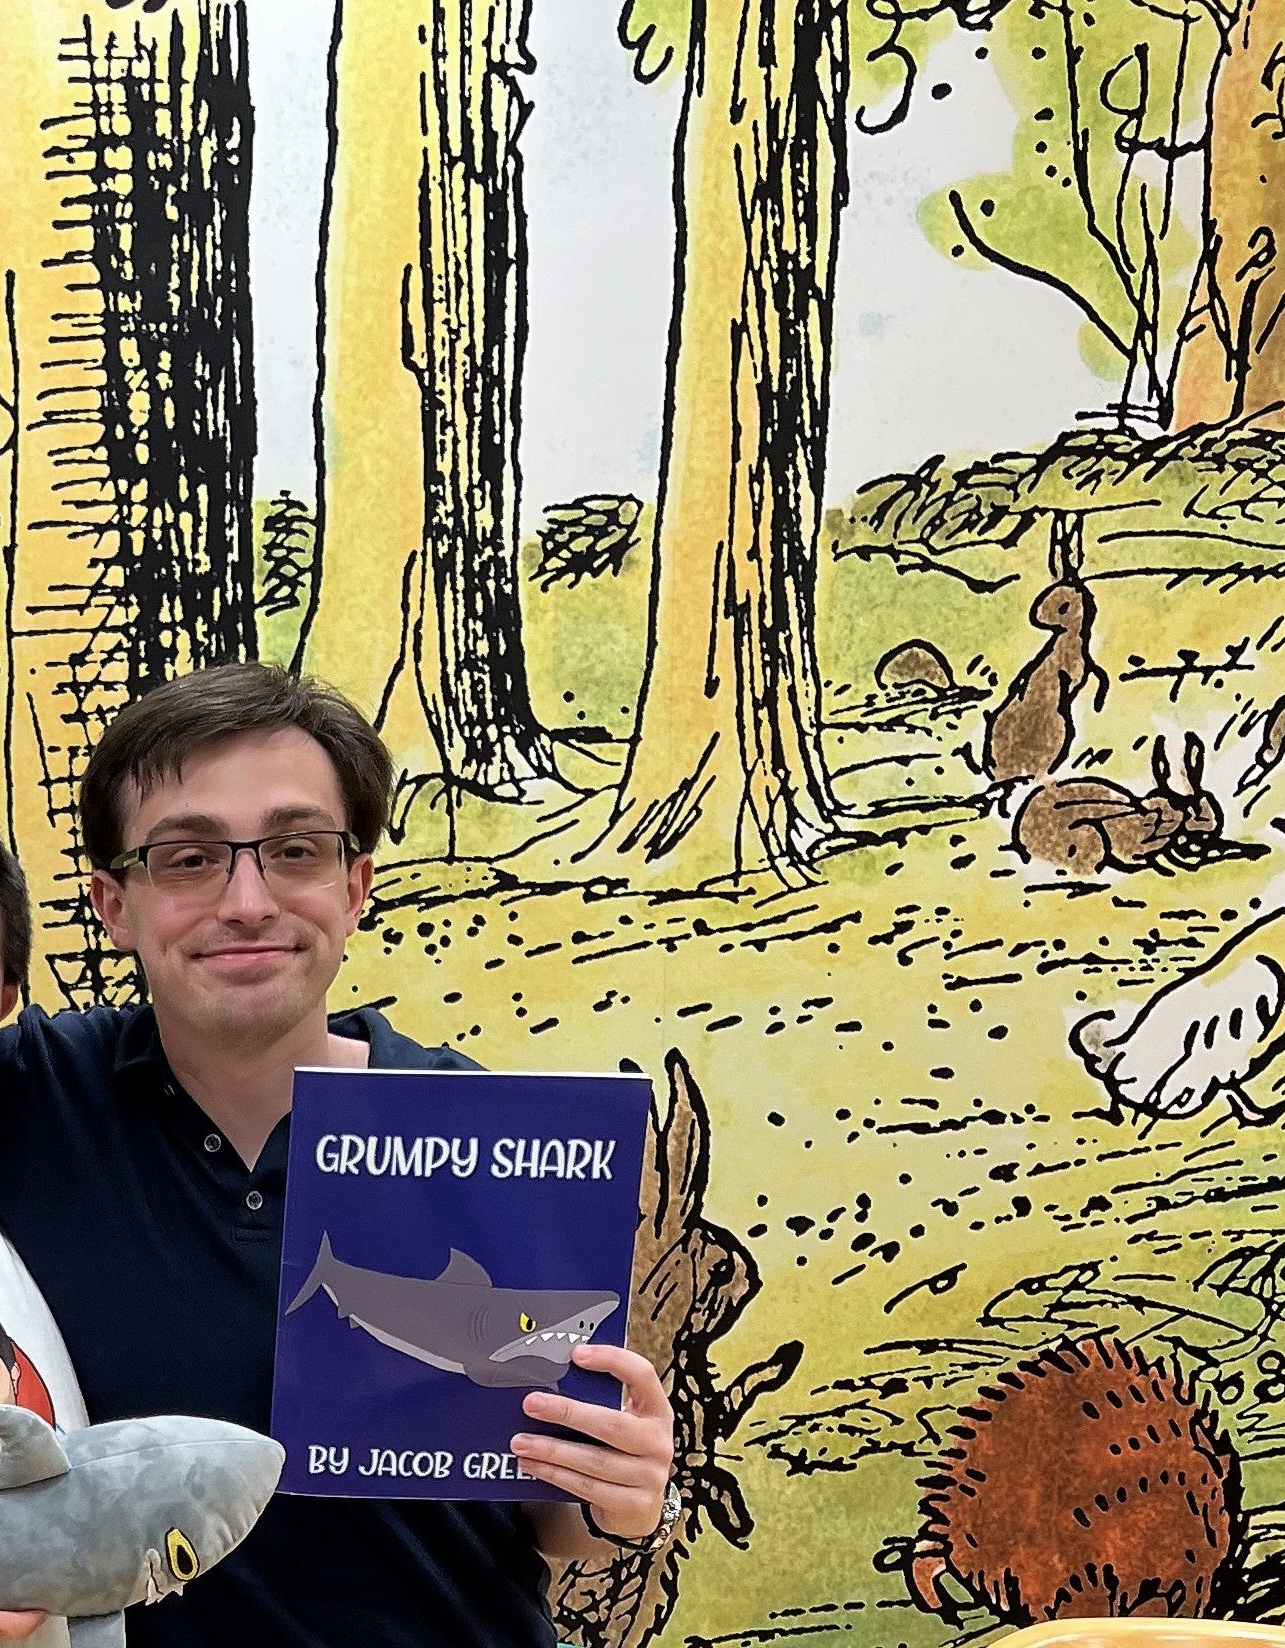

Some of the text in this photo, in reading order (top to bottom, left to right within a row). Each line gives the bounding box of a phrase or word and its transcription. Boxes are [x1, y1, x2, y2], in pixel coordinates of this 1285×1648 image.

[316, 1134, 616, 1180] GRUMPY SHARK
[308, 1445, 350, 1476] BY
[358, 1448, 454, 1479] JACOB
